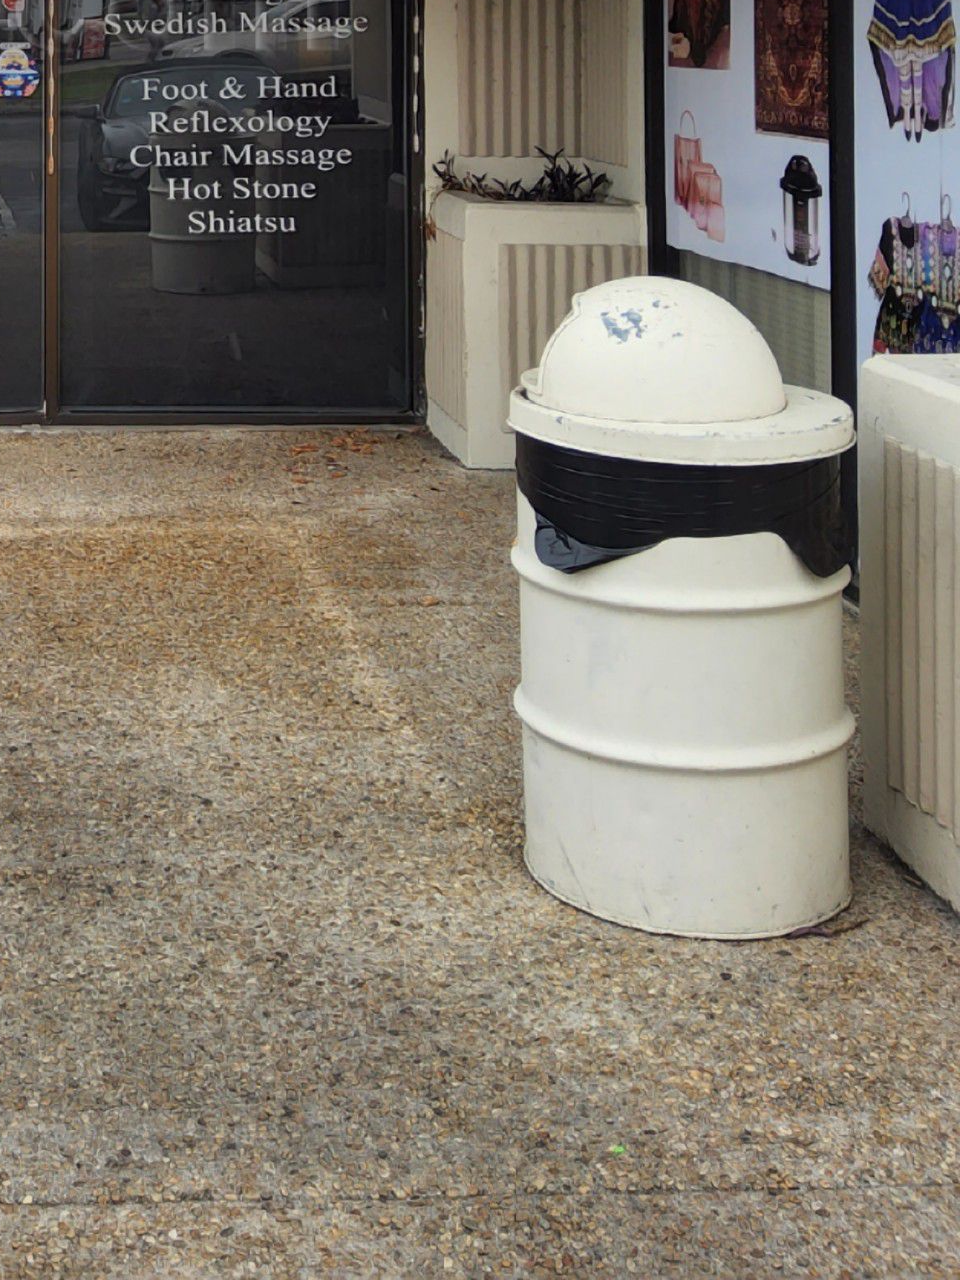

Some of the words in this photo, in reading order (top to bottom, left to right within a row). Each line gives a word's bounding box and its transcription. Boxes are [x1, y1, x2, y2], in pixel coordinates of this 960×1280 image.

[103, 12, 228, 36] Swedish
[240, 12, 369, 39] Massage
[141, 78, 210, 101] Foot
[218, 77, 246, 100] &
[256, 75, 338, 99] Hand
[147, 110, 333, 137] Reflexology
[129, 143, 213, 168] Chair
[222, 144, 353, 170] Massage
[166, 177, 222, 201] Hot
[232, 176, 317, 200] Stone
[187, 210, 297, 234] Shiatsu
